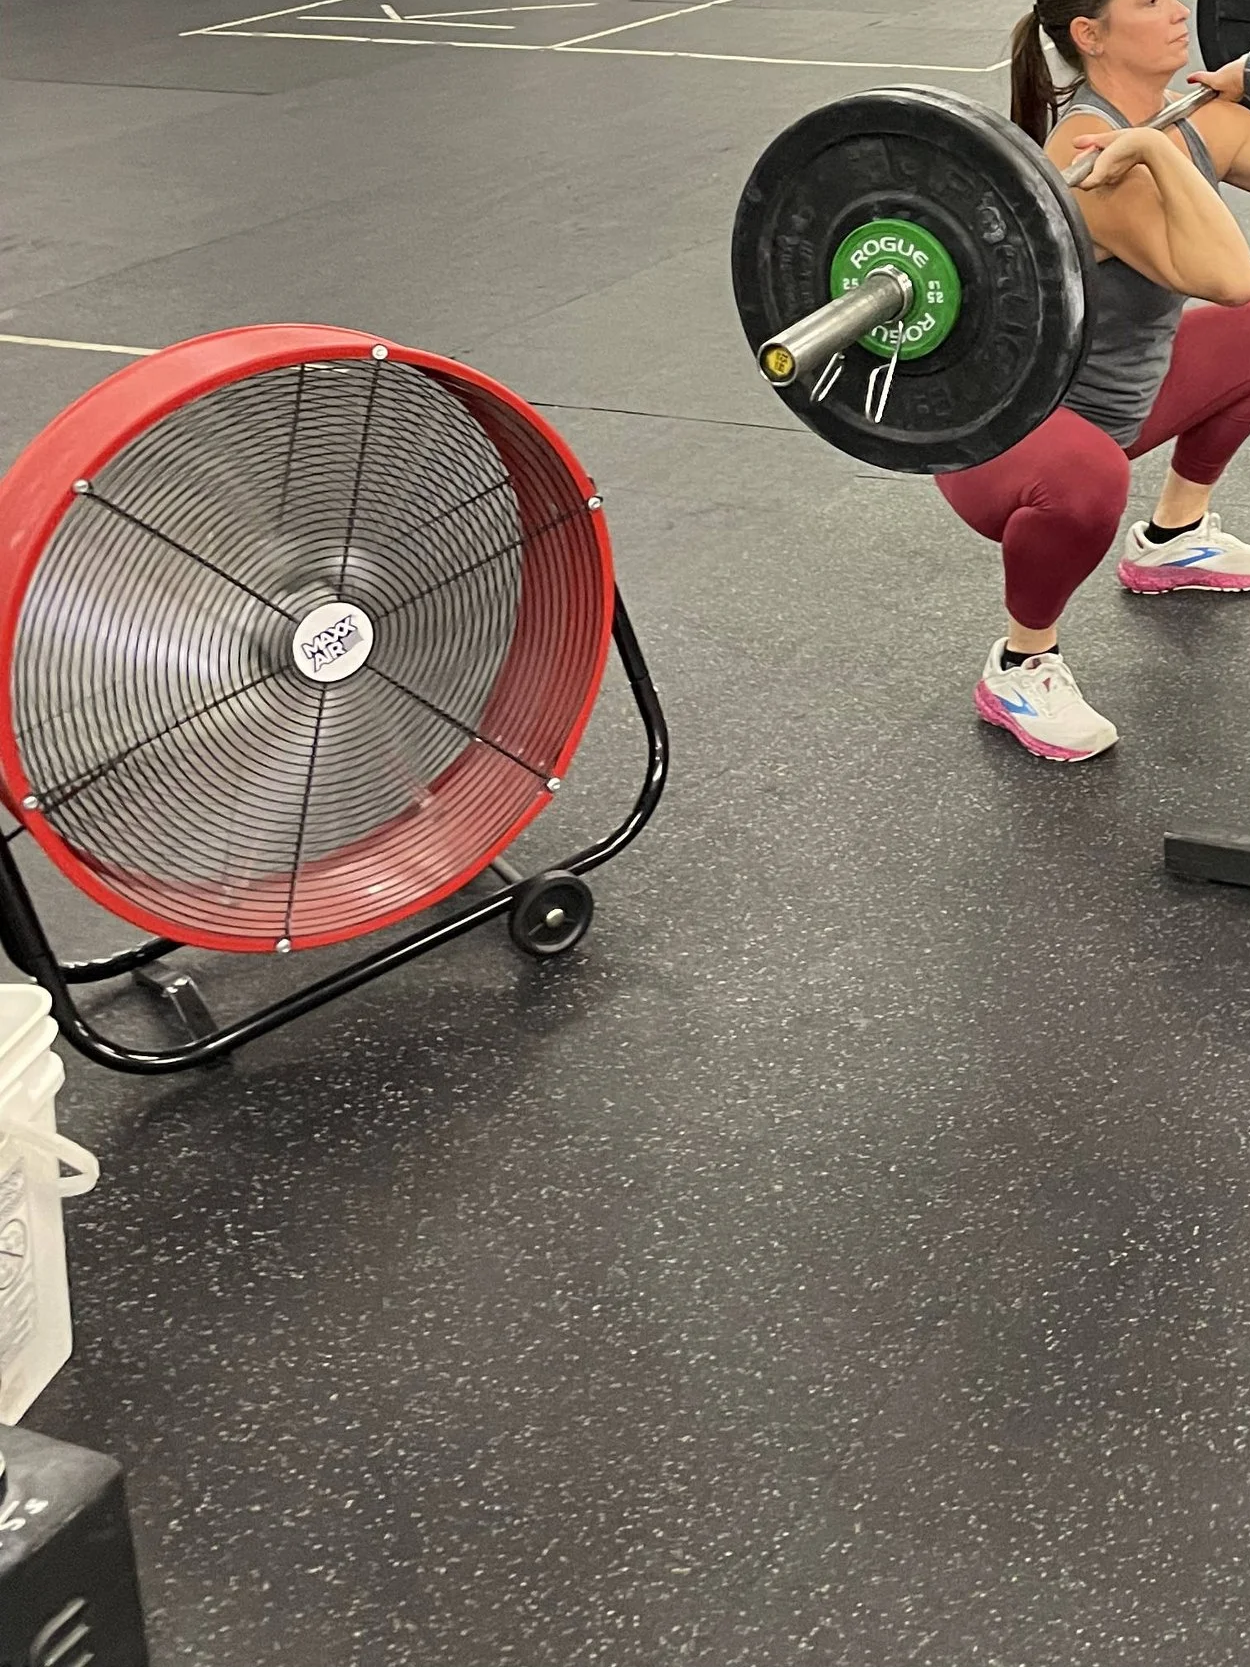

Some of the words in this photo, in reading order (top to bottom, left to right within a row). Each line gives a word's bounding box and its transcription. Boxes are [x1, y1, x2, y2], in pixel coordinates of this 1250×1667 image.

[850, 236, 930, 270] ROGUE
[842, 278, 860, 291] 25
[926, 291, 945, 304] 25
[871, 312, 936, 344] ROGU
